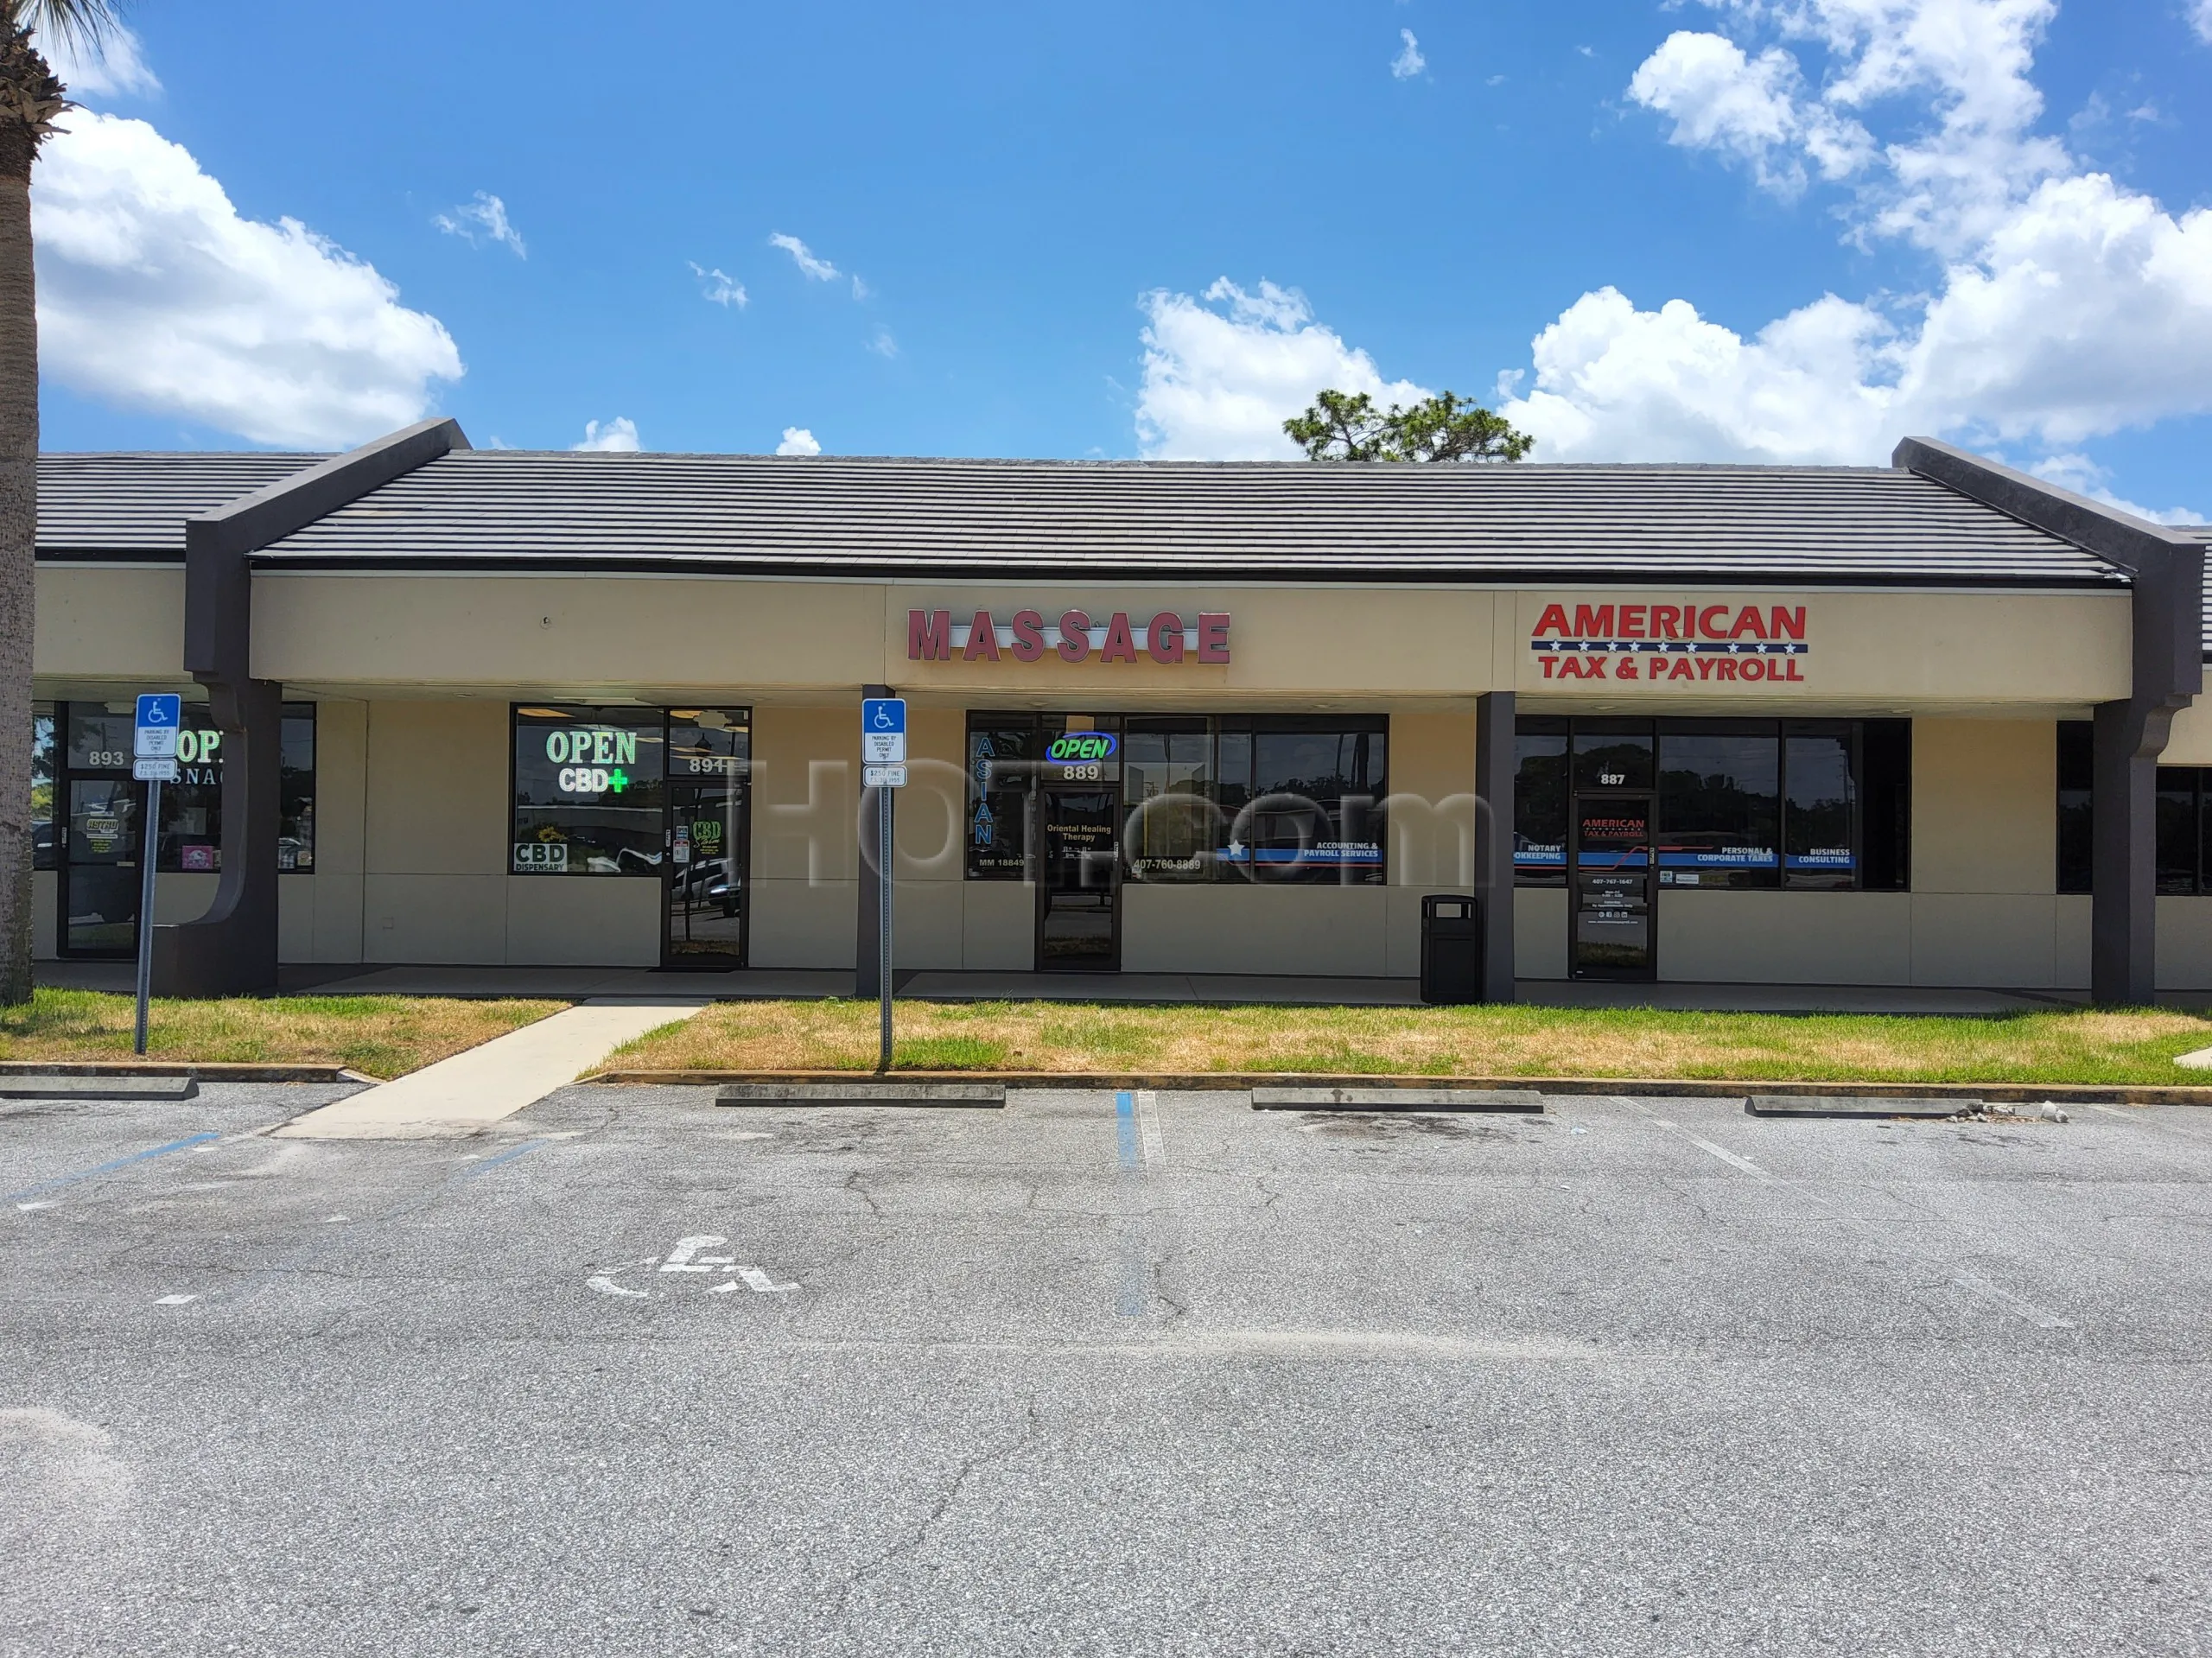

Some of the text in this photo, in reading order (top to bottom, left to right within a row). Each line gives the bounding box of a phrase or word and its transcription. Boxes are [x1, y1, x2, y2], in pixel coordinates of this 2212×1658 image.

[1530, 604, 1807, 639] AMERICAN
[906, 608, 1231, 664] MASSAGE
[1538, 656, 1804, 682] TAX & PAYROLL
[545, 730, 638, 765] OPEN
[1050, 739, 1109, 759] OPEN
[88, 751, 124, 765] 893
[169, 768, 224, 785] SNA
[1063, 765, 1099, 780] 889
[1600, 774, 1625, 785] 887
[974, 737, 995, 845] ASIAN
[692, 821, 721, 840] CBD
[1046, 824, 1112, 835] Oriental Healing
[1582, 819, 1645, 828] AMERICAN
[1063, 833, 1096, 842] Therapy
[516, 844, 565, 862] CBD
[1697, 854, 1748, 862] CORPORATE
[1798, 855, 1850, 864] CONSULTING
[1134, 859, 1201, 870] 407-760-8889
